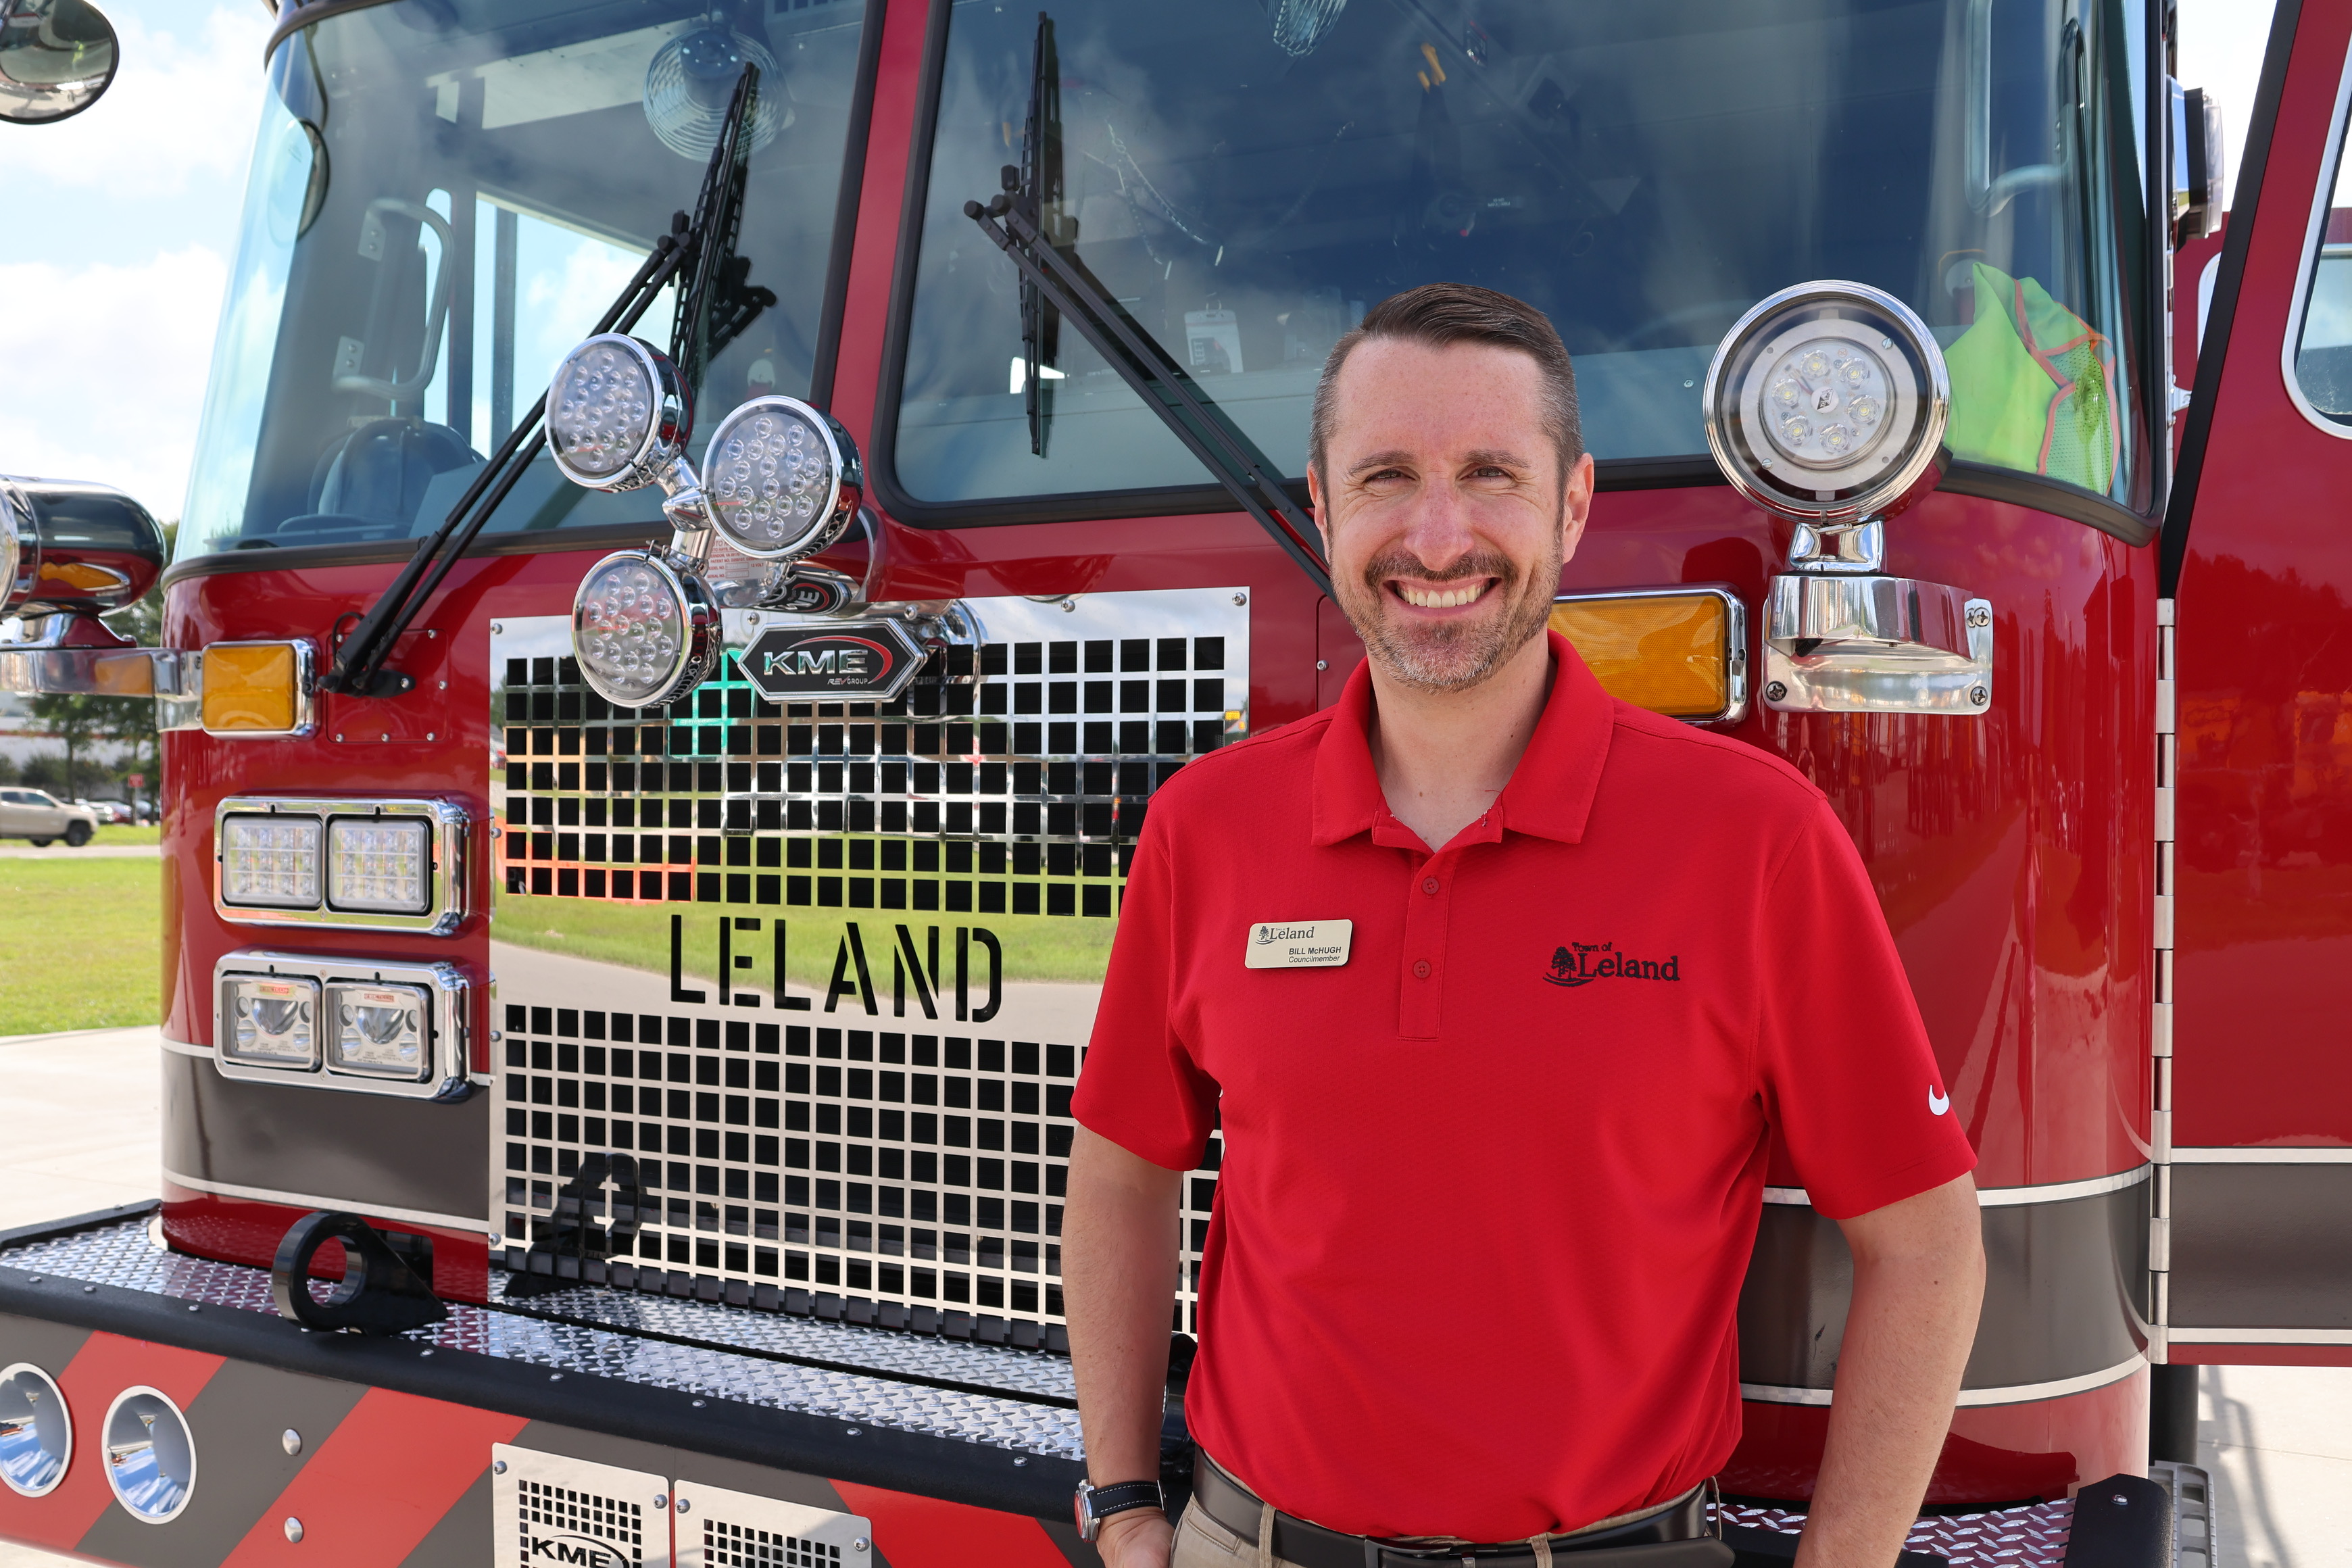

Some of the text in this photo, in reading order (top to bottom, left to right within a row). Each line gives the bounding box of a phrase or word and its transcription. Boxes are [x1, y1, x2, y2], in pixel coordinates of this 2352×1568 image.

[763, 649, 868, 675] KME
[827, 675, 850, 685] REV
[1269, 926, 1315, 940] Leland
[1308, 946, 1342, 954] McHUGH
[1571, 941, 1613, 952] Town of
[1289, 955, 1340, 963] Councilmember
[670, 914, 1002, 1023] LELAND
[1577, 952, 1680, 981] Leland
[532, 1536, 611, 1568] KME
